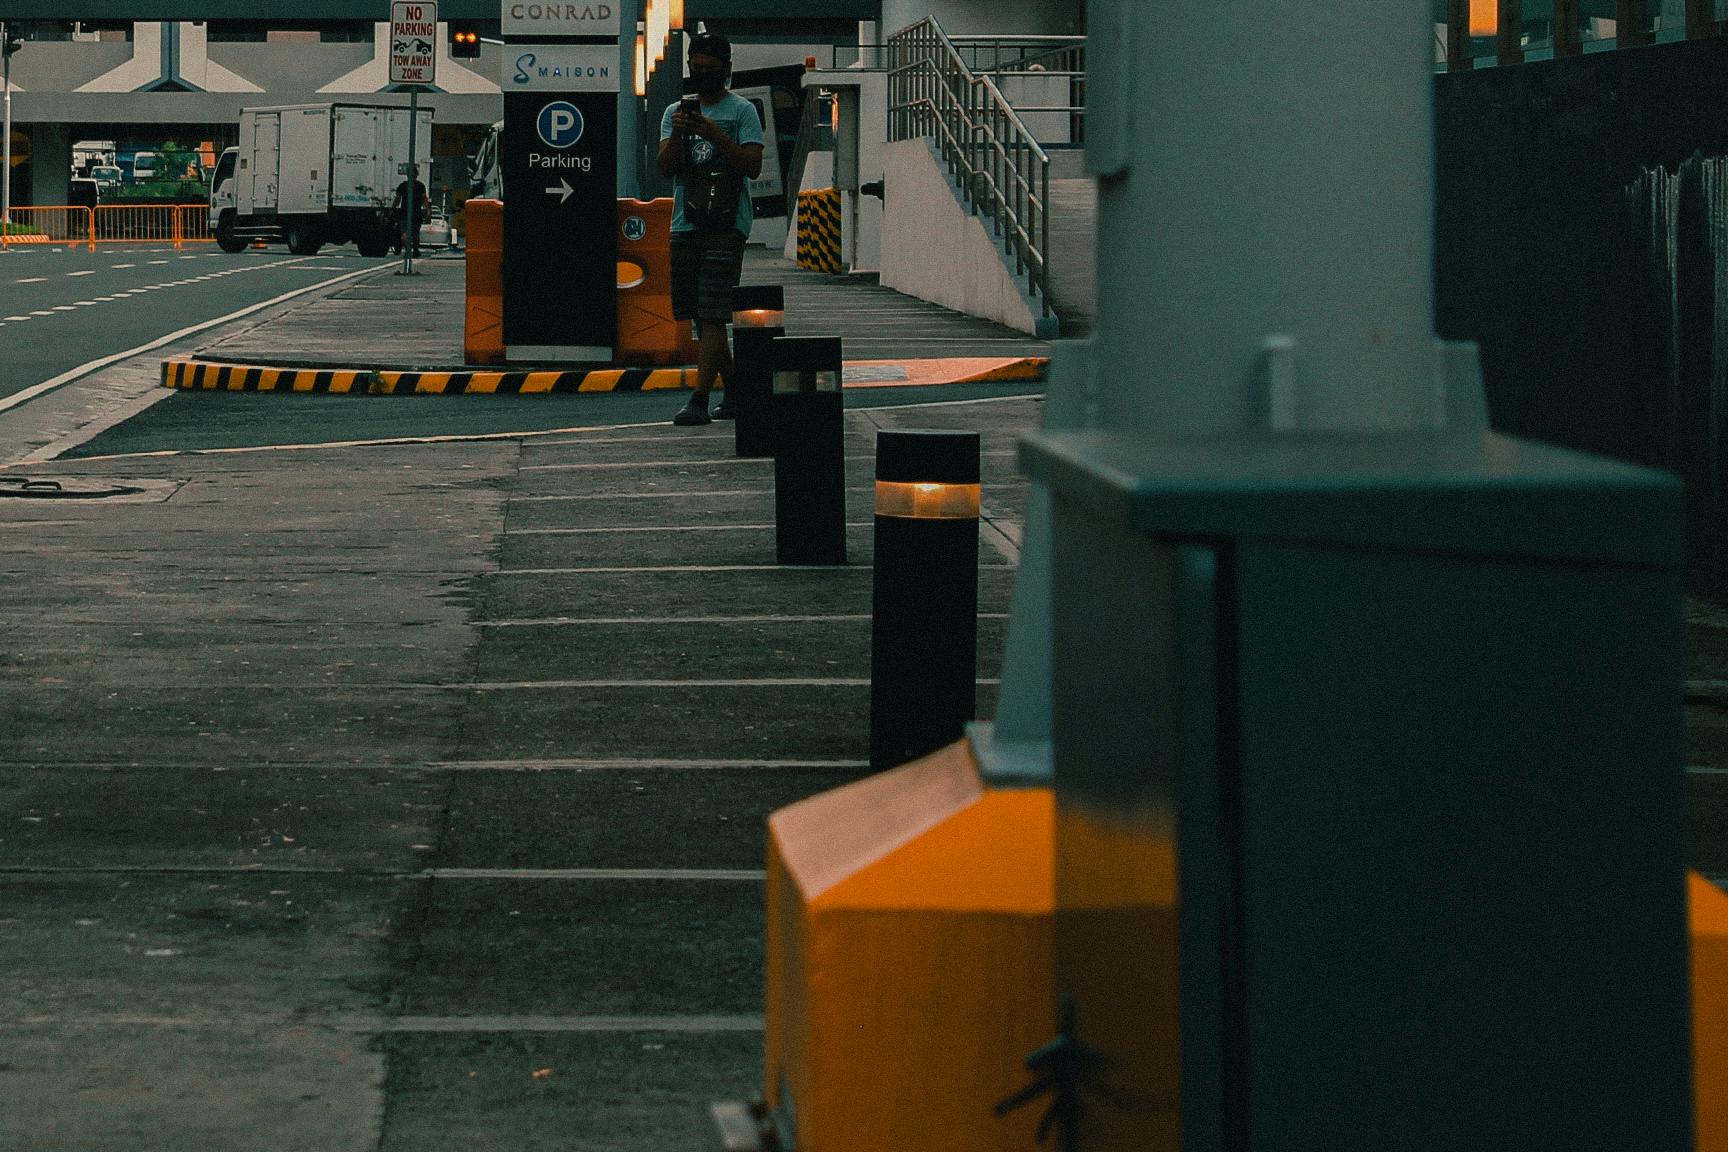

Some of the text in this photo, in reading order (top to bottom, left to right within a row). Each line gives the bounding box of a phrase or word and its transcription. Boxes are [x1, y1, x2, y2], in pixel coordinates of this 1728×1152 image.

[406, 6, 422, 20] NO
[511, 4, 611, 20] CONRAD
[394, 22, 433, 36] PARKING
[393, 54, 432, 67] TOW AWAY
[401, 68, 423, 80] ZONE
[551, 109, 575, 140] P
[529, 153, 591, 172] Parking
